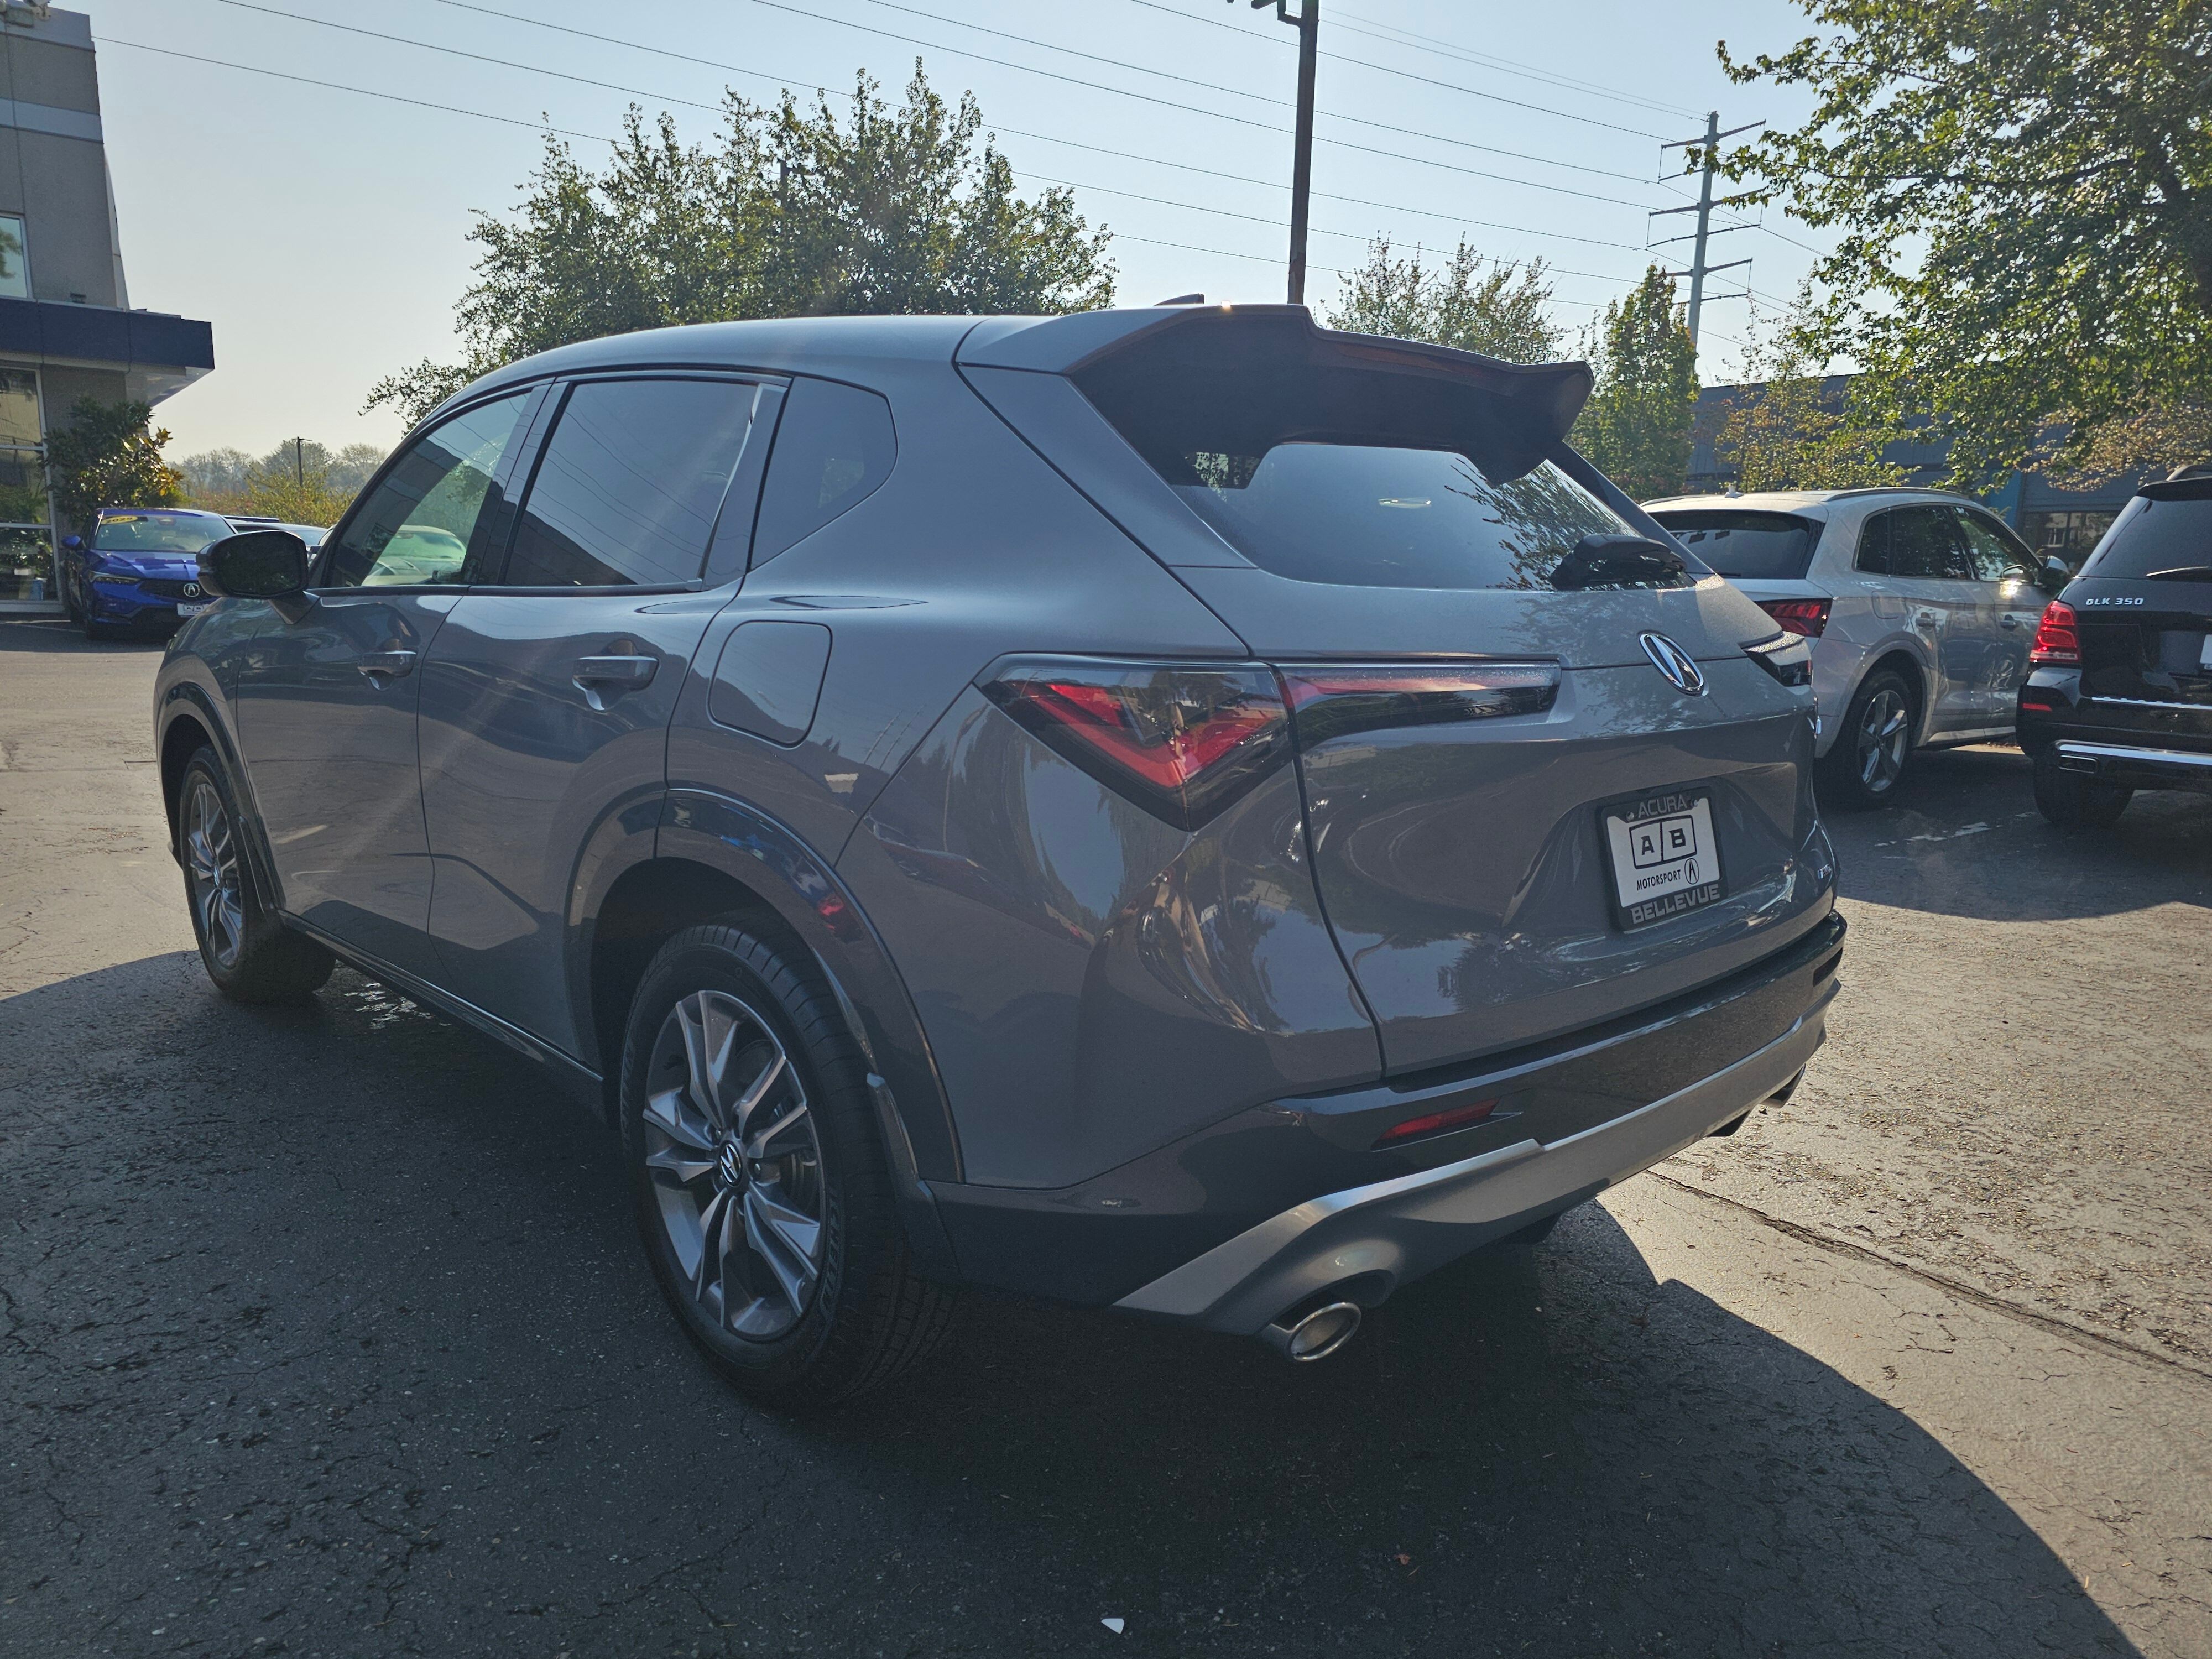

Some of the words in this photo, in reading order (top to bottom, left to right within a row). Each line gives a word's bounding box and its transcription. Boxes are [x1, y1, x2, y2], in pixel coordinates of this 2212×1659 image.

[1639, 794, 1686, 818] ACURA
[1641, 836, 1655, 855] A
[1669, 828, 1686, 848] B
[1637, 869, 1681, 891] MOTORSPORT
[1631, 884, 1720, 924] BELLEVUE
